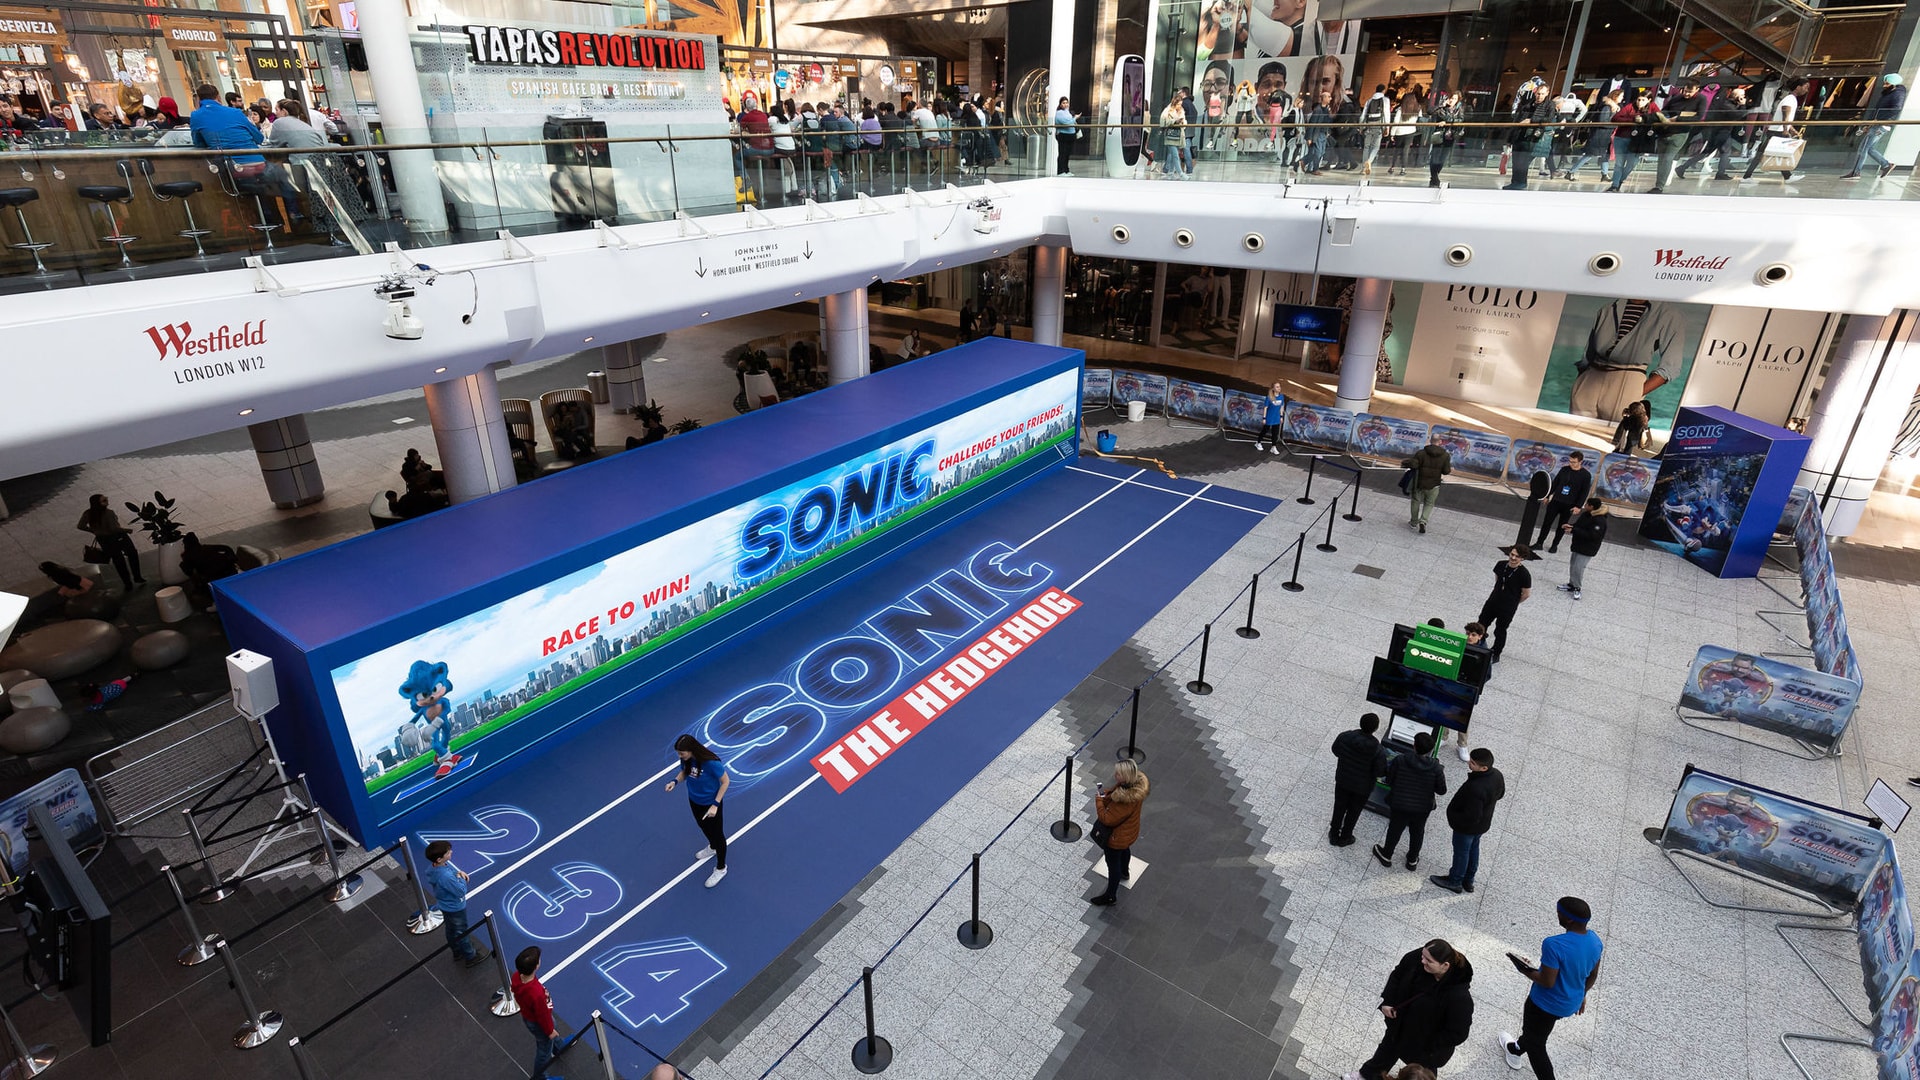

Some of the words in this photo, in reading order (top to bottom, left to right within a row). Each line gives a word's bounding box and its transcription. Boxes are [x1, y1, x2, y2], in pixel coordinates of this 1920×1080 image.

[0, 19, 58, 35] CERVEZA
[172, 29, 217, 42] CHORIZO
[257, 57, 302, 69] CHURS
[511, 81, 558, 97] SPANISH
[562, 82, 587, 96] CAFE
[590, 82, 610, 96] BAR
[612, 84, 620, 96] &
[623, 82, 681, 97] RESTAURANT
[734, 247, 754, 257] JOHN
[756, 243, 779, 253] LEWIS
[747, 253, 772, 261] PARTNERS
[1653, 248, 1734, 271] Westfield
[712, 267, 727, 278] HOME
[728, 263, 751, 275] QUARTER
[755, 259, 781, 270] WESTFIELD
[781, 255, 799, 265] SQUARE
[1654, 271, 1693, 282] LONDON
[1695, 273, 1715, 283] W12
[1446, 284, 1538, 310] POLO
[1452, 305, 1482, 315] RALPH
[1486, 309, 1522, 319] LAUREN
[142, 318, 268, 362] Westfield
[1488, 328, 1510, 336] STORE
[1707, 338, 1805, 366] POLO
[174, 361, 235, 384] LONDON
[237, 356, 266, 373] W12
[1716, 359, 1743, 368] RALPH
[1757, 363, 1791, 373] LAUREN
[1322, 416, 1352, 426] SONIC
[1675, 424, 1725, 440] SONIC
[938, 434, 998, 472] CHALLENGE
[999, 422, 1025, 441] YOUR
[1026, 403, 1065, 430] FRIENDS!
[1394, 428, 1427, 439] SONIC
[1473, 441, 1507, 453] SONIC
[735, 438, 937, 581] SONIC
[542, 614, 600, 657] RACE
[606, 600, 635, 627] TO
[642, 574, 691, 611] WIN!
[704, 541, 1054, 777] SONIC
[819, 709, 912, 783] THE
[903, 590, 1078, 720] HEDGEHOG
[1781, 683, 1851, 707] SONIC
[416, 804, 540, 876] 2
[1788, 824, 1876, 858] SONIC
[502, 861, 624, 941] 3
[1888, 914, 1904, 961] SONIC
[591, 936, 729, 1028] 4
